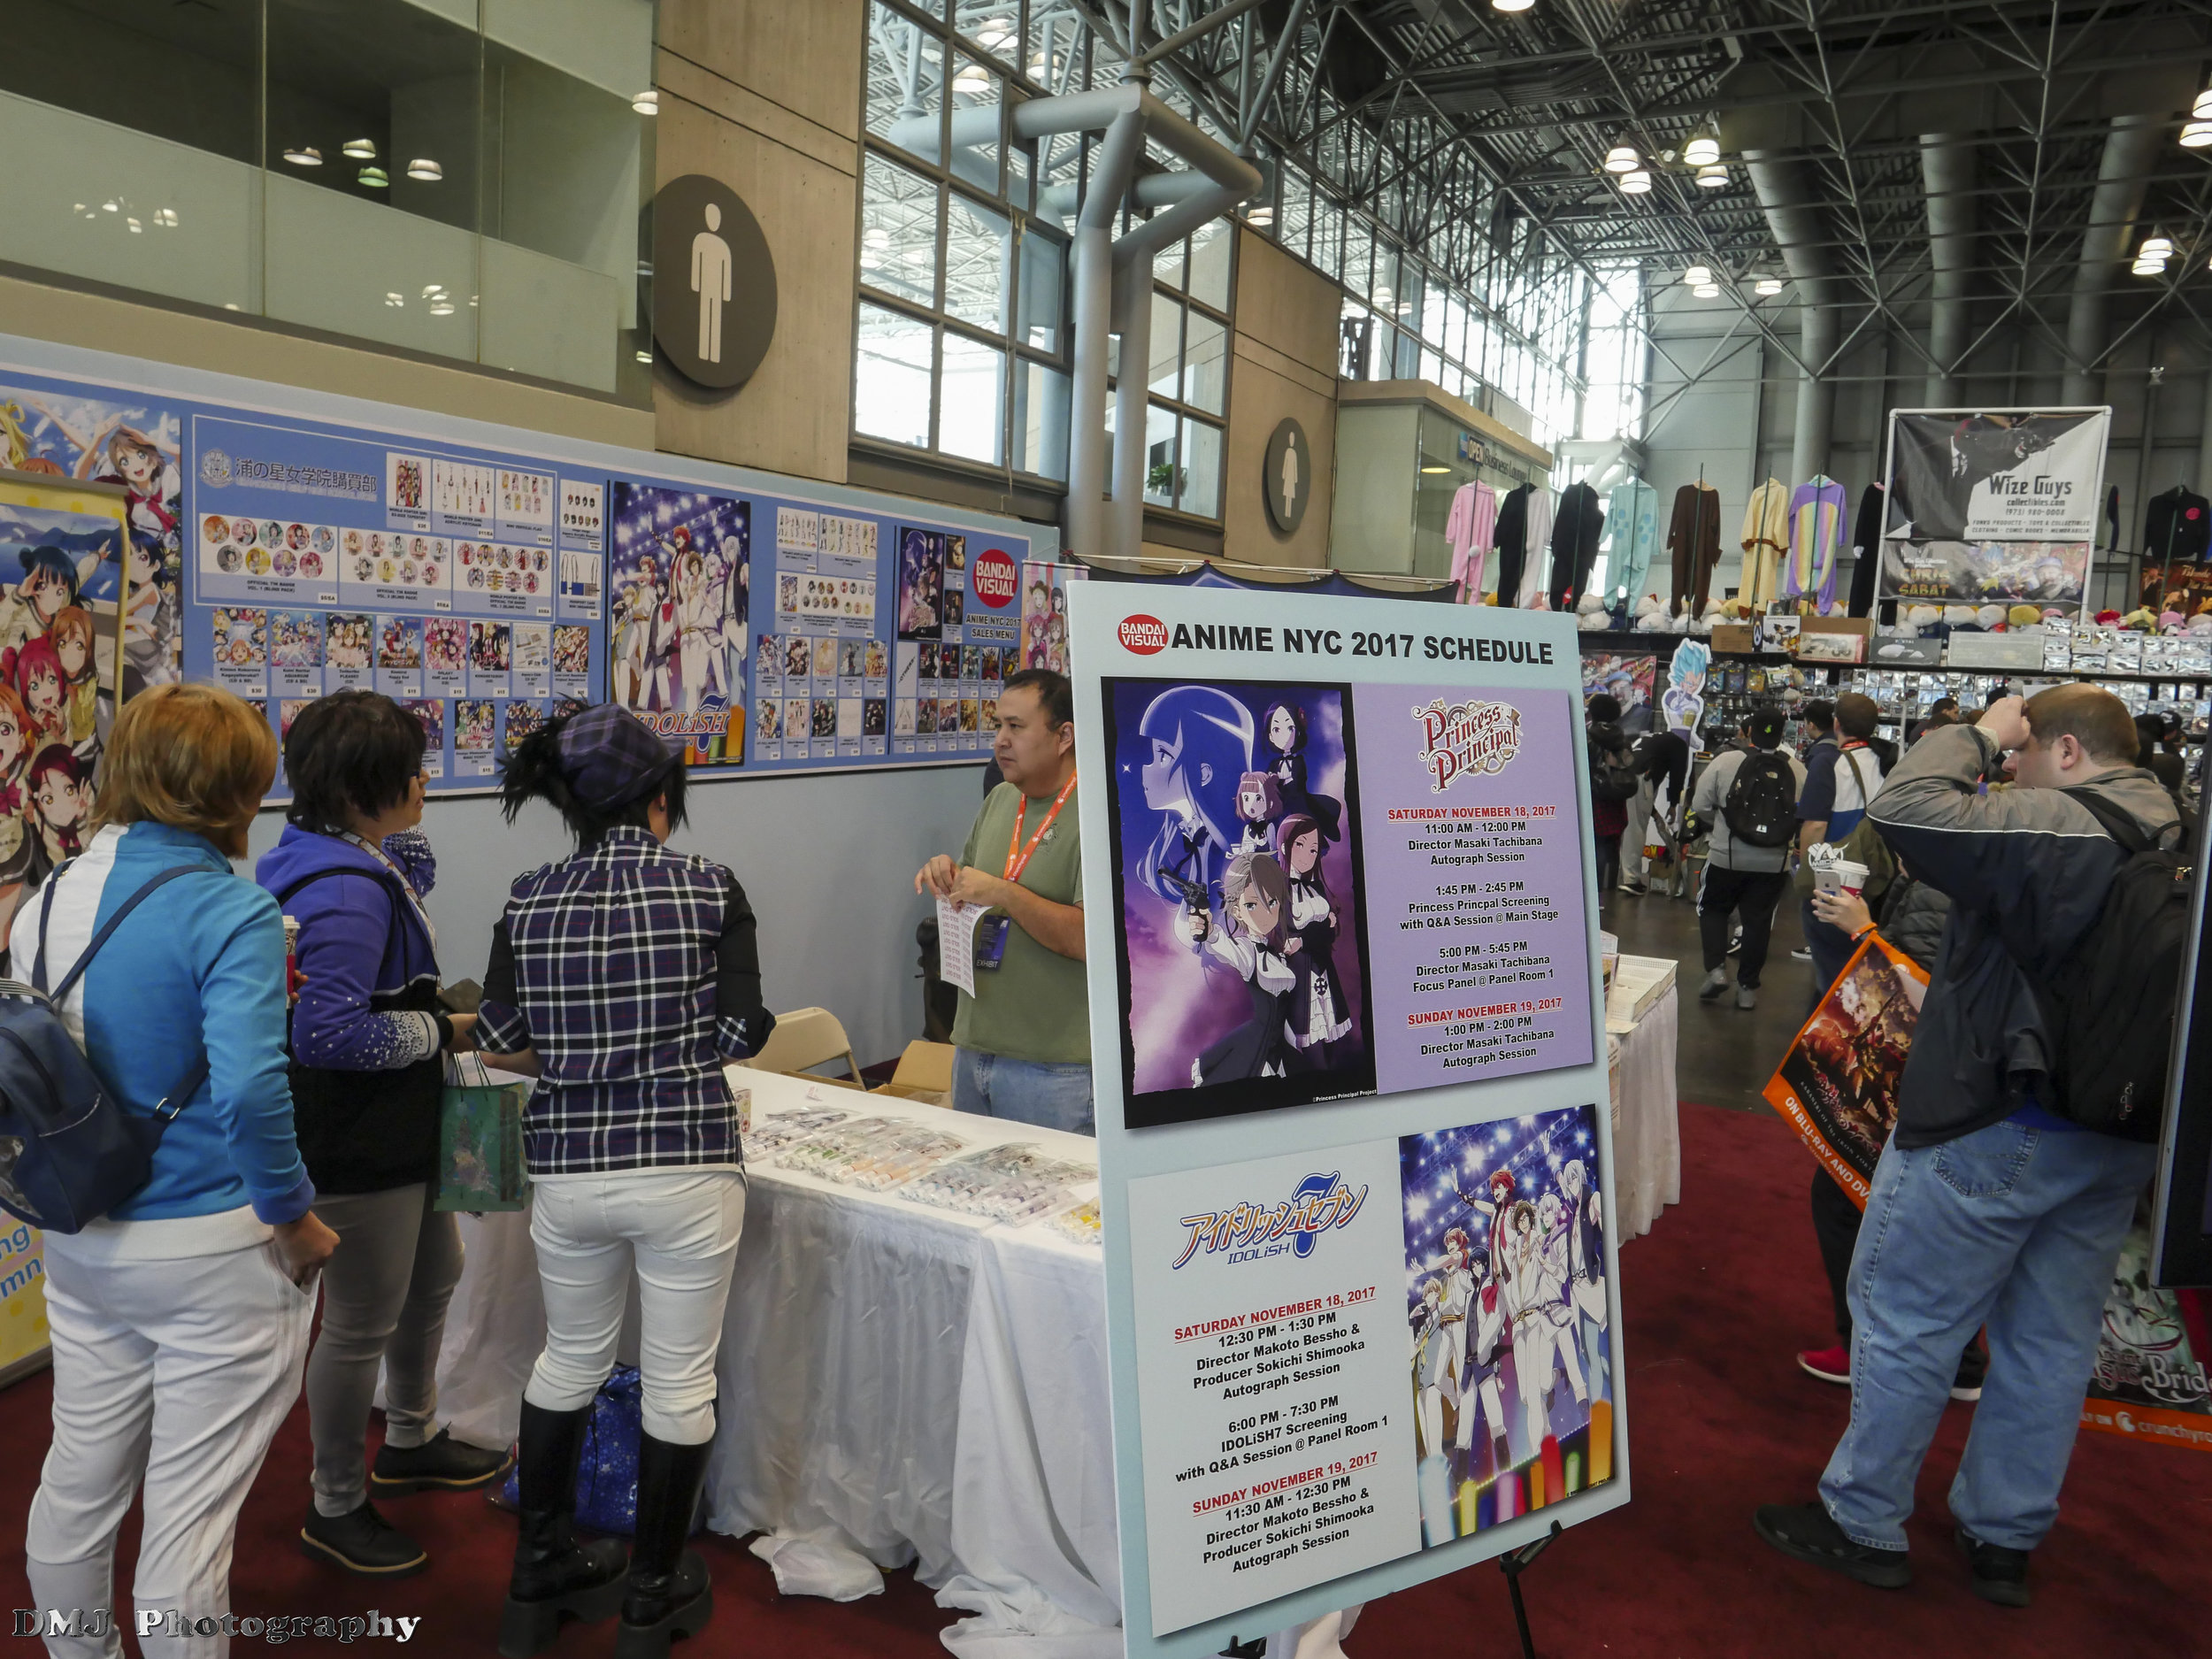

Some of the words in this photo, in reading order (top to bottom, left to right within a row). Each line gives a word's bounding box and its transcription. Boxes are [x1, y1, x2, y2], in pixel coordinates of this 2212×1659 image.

[1989, 475, 2029, 495] Wize
[2033, 475, 2072, 499] Guys
[976, 560, 1016, 580] BANDAI
[976, 578, 1015, 596] VISUAL
[965, 614, 988, 625] ANIME
[989, 617, 1004, 626] NYC
[1005, 618, 1021, 627] 2017
[1120, 622, 1165, 635] BANDAI
[972, 628, 994, 639] SALES
[995, 630, 1015, 640] MENU
[1121, 634, 1166, 647] VISUAL
[1171, 624, 1273, 651] ANIME
[1284, 629, 1342, 655] NYC
[1352, 632, 1414, 657] 2017
[1425, 636, 1553, 664] SCHEDULE
[1413, 706, 1502, 759] Princess
[1429, 727, 1518, 792] Principal
[1388, 808, 1448, 820] SATURDAY
[1451, 807, 1511, 818] NOVEMBER
[1514, 806, 1530, 818] 18,
[1532, 806, 1555, 816] 2017
[1425, 823, 1454, 834] 11:00
[1456, 823, 1473, 833] AM
[1481, 821, 1509, 833] 12:00
[1510, 821, 1526, 832] PM
[1408, 840, 1452, 850] Director
[1454, 837, 1490, 849] Masaki
[1492, 836, 1542, 847] Tachibana
[1430, 853, 1484, 867] Autograph
[1486, 852, 1525, 863] Session
[1435, 885, 1458, 896] 1:45
[1461, 884, 1477, 895] PM
[1485, 882, 1507, 893] 2:45
[1509, 880, 1524, 892] PM
[1409, 902, 1455, 914] Princess
[1457, 897, 1499, 911] Princpal
[1501, 896, 1549, 908] Screening
[1399, 918, 1424, 930] with
[1426, 917, 1451, 928] Q&A
[1454, 916, 1494, 926] Session
[1505, 911, 1529, 922] Main
[1531, 910, 1559, 922] Stage
[1440, 947, 1462, 958] 5:00
[1464, 945, 1480, 956] PM
[1489, 941, 1510, 954] 5:45
[1512, 941, 1528, 952] PM
[1416, 964, 1460, 977] Director
[1462, 959, 1498, 972] Masaki
[1500, 956, 1550, 968] Tachibana
[1413, 981, 1445, 993] Focus
[1448, 976, 1477, 989] Panel
[1488, 972, 1517, 985] Panel
[1518, 972, 1546, 981] Room
[1408, 1010, 1454, 1025] SUNDAY
[1457, 1002, 1517, 1019] NOVEMBER
[1520, 1001, 1536, 1013] 19,
[1538, 997, 1562, 1010] 2017
[1444, 1024, 1466, 1036] 1:00
[1469, 1022, 1485, 1033] PM
[1493, 1018, 1515, 1031] 2:00
[1517, 1016, 1532, 1027] PM
[1420, 1041, 1464, 1056] Director
[1466, 1035, 1502, 1049] Masaki
[1504, 1030, 1555, 1044] Tachibana
[1442, 1051, 1496, 1069] Autograph
[1498, 1048, 1537, 1061] Session
[1785, 1096, 1801, 1116] ON
[1794, 1112, 1832, 1158] BLU-RAY
[1829, 1158, 1855, 1187] AND
[1850, 1179, 1870, 1202] DV
[1172, 1185, 1369, 1270] アイドリッシュセブン
[1226, 1242, 1290, 1265] IDOLiSH
[1174, 1314, 1247, 1340] SATURDAY
[1250, 1298, 1323, 1324] NOVEMBER
[1325, 1294, 1345, 1308] 18,
[1348, 1286, 1376, 1302] 2017
[1218, 1330, 1254, 1348] 12:30
[1257, 1325, 1277, 1340] PM
[1288, 1317, 1315, 1333] 1:30
[1317, 1311, 1337, 1326] PM
[1196, 1350, 1250, 1371] Director
[1253, 1339, 1300, 1358] Makoto
[1302, 1328, 1348, 1347] Bessho
[1193, 1367, 1254, 1389] Producer
[1256, 1353, 1302, 1374] Sokichi
[1305, 1340, 1365, 1363] Shimooka
[1223, 1374, 1290, 1401] Autograph
[1293, 1363, 1340, 1383] Session
[1228, 1416, 1256, 1433] 6:00
[1260, 1409, 1279, 1425] PM
[1290, 1401, 1317, 1417] 7:30
[1320, 1394, 1339, 1409] PM
[1221, 1425, 1282, 1453] IDOLiSH7
[1286, 1411, 1348, 1436] Screening
[1175, 1465, 1205, 1483] with
[1209, 1455, 1240, 1473] Q&A
[1242, 1443, 1293, 1464] Session
[1307, 1427, 1342, 1448] Panel
[1344, 1420, 1379, 1437] Room
[1193, 1487, 1248, 1514] SUNDAY
[1252, 1467, 1324, 1497] NOVEMBER
[1328, 1462, 1346, 1475] 19,
[1349, 1451, 1378, 1470] 2017
[1225, 1502, 1261, 1522] 11:30
[1263, 1494, 1284, 1511] AM
[1295, 1482, 1329, 1501] 12:30
[1332, 1475, 1351, 1491] PM
[1206, 1521, 1260, 1546] Director
[1263, 1507, 1310, 1529] Makoto
[1312, 1494, 1357, 1514] Bessho
[1202, 1538, 1263, 1564] Producer
[1265, 1520, 1312, 1545] Sokichi
[1315, 1504, 1374, 1530] Shimooka
[1232, 1543, 1299, 1573] Autograph
[1302, 1529, 1350, 1551] Session
